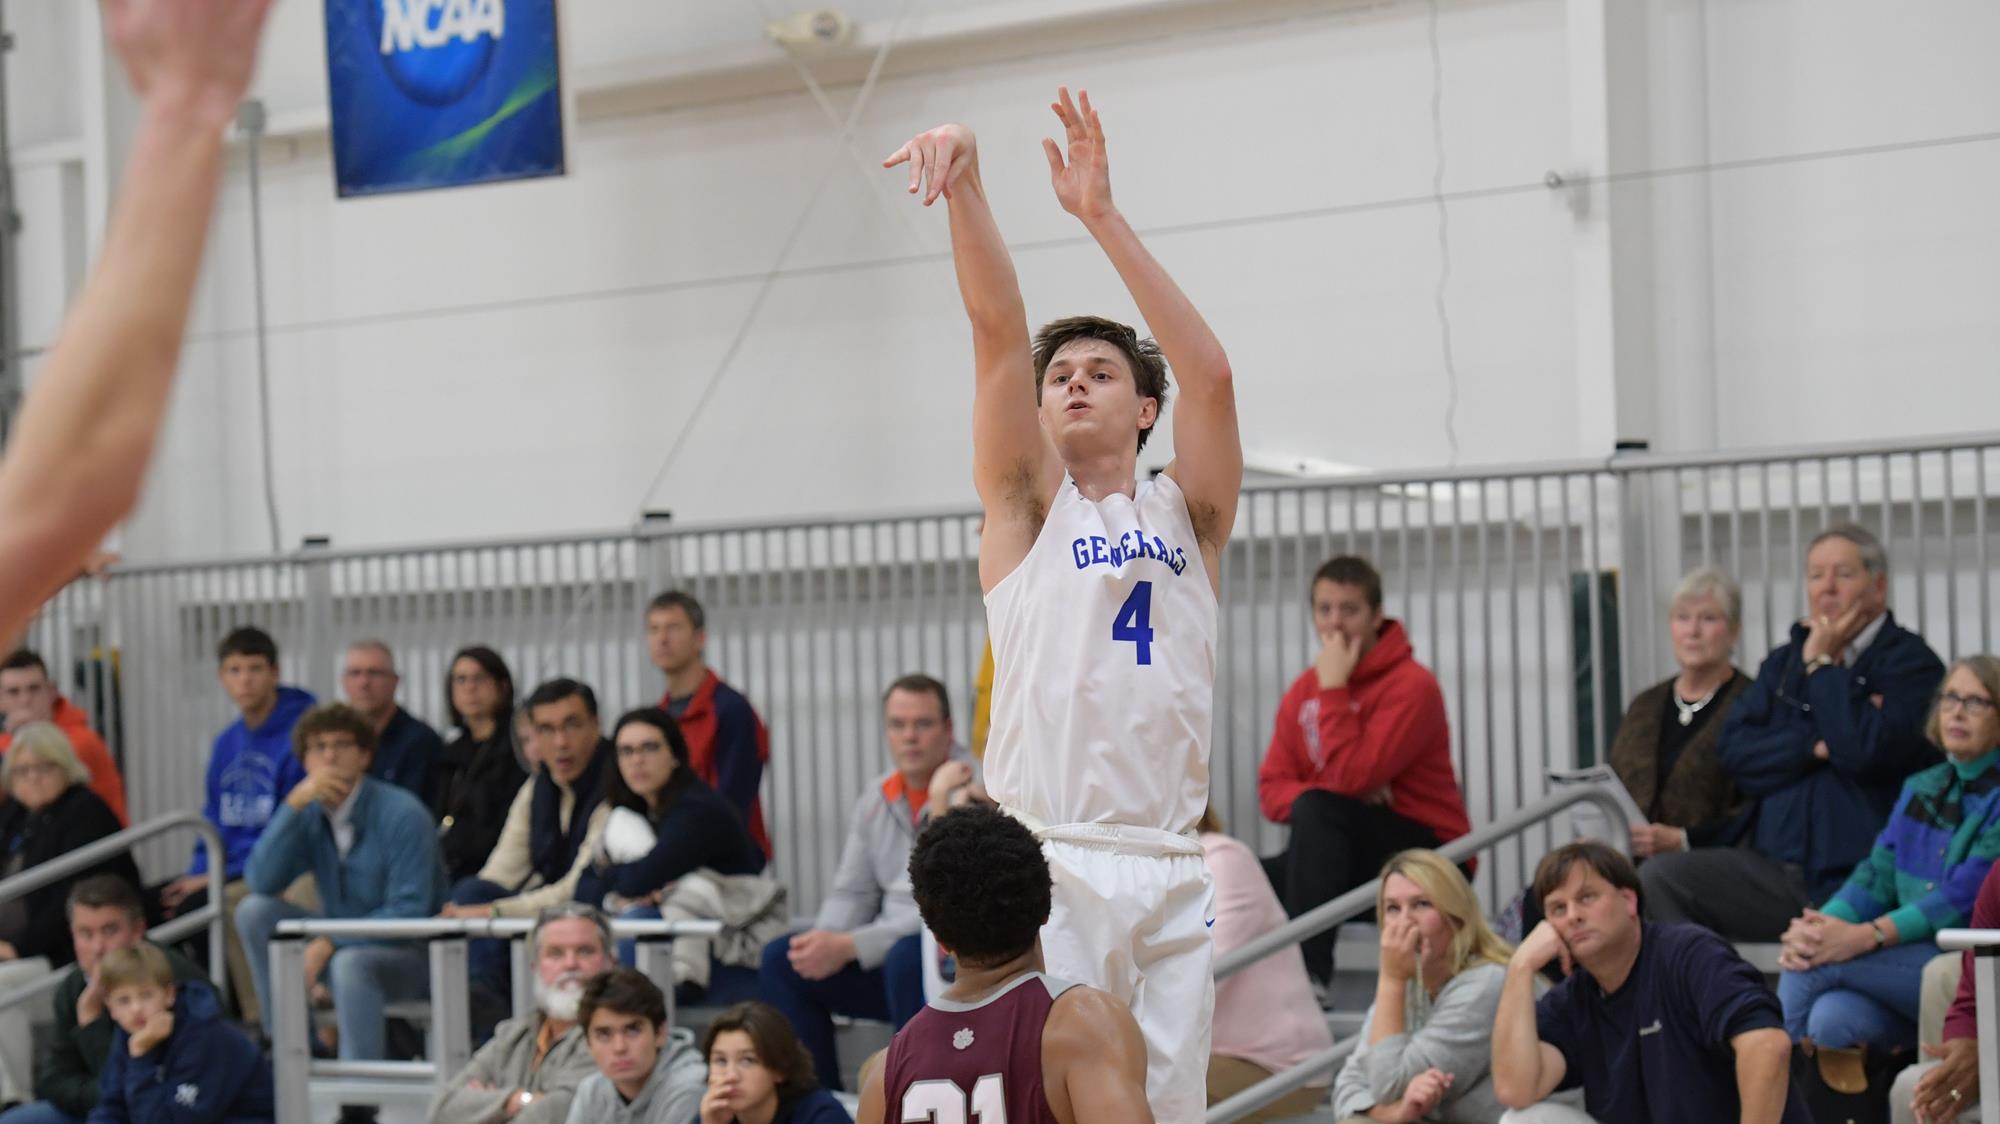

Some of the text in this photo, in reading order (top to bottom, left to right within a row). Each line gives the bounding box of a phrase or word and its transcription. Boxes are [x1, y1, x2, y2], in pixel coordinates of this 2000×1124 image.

[380, 0, 505, 54] NCAA
[1072, 530, 1187, 576] GENERALS
[1112, 581, 1154, 665] 4
